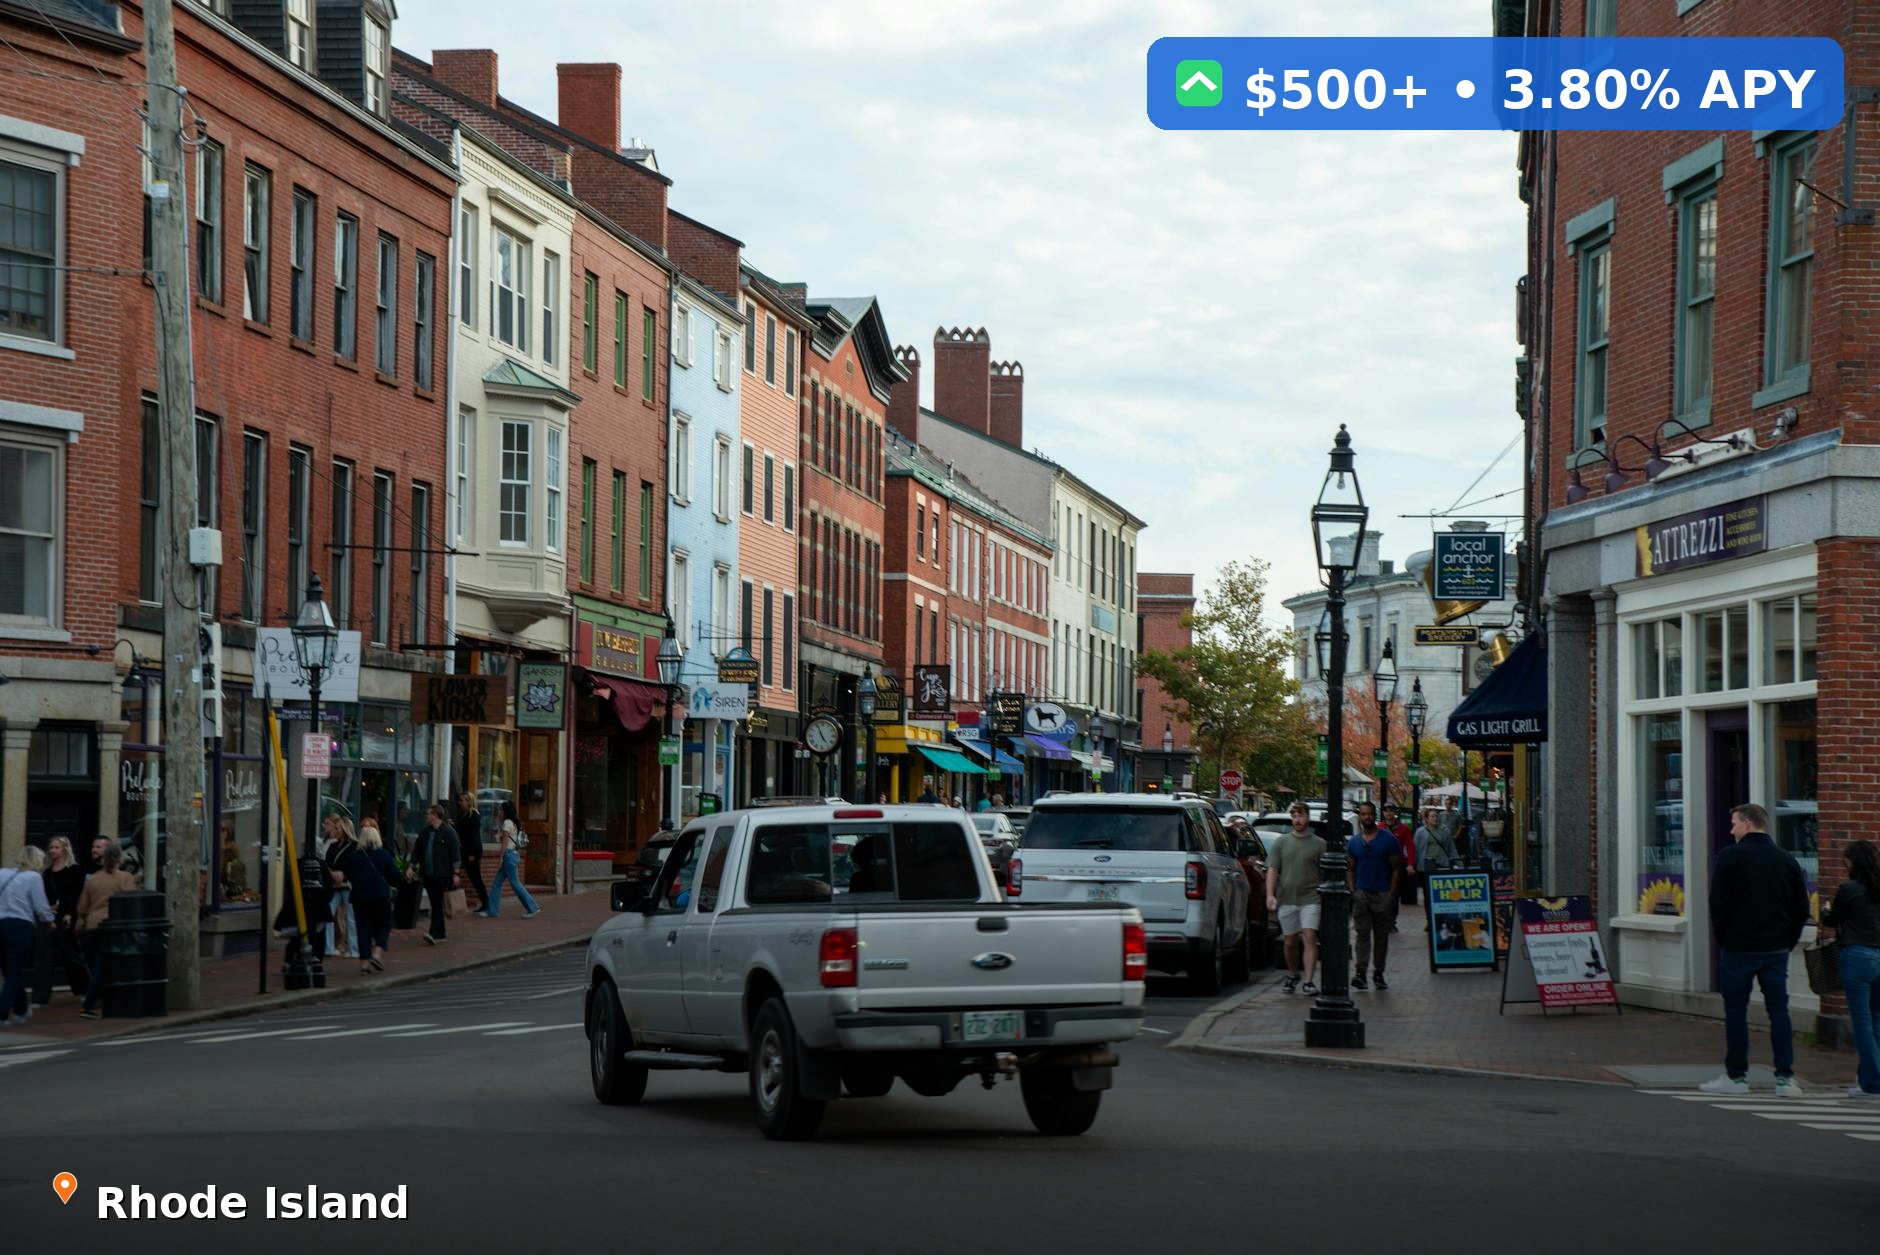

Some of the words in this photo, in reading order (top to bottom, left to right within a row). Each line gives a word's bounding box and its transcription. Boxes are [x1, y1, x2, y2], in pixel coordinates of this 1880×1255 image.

[1451, 537, 1486, 551] local
[1653, 515, 1725, 565] ATTREZZI
[1443, 549, 1495, 565] anchor
[428, 678, 487, 698] FLOWER
[428, 696, 487, 721] KIOSK
[715, 697, 746, 708] SIREN
[1456, 721, 1478, 735] GAS
[1480, 720, 1509, 735] LIGHT
[1511, 718, 1542, 733] GRILL
[122, 759, 163, 792] Prelude
[1221, 776, 1242, 786] STOP
[226, 769, 258, 800] Prelude
[1432, 878, 1486, 890] HAPPY
[1440, 889, 1482, 901] HOUR
[1527, 924, 1542, 933] WE
[1543, 923, 1562, 932] ARE
[1544, 985, 1576, 994] ORDER
[1576, 982, 1609, 992] ONLINE
